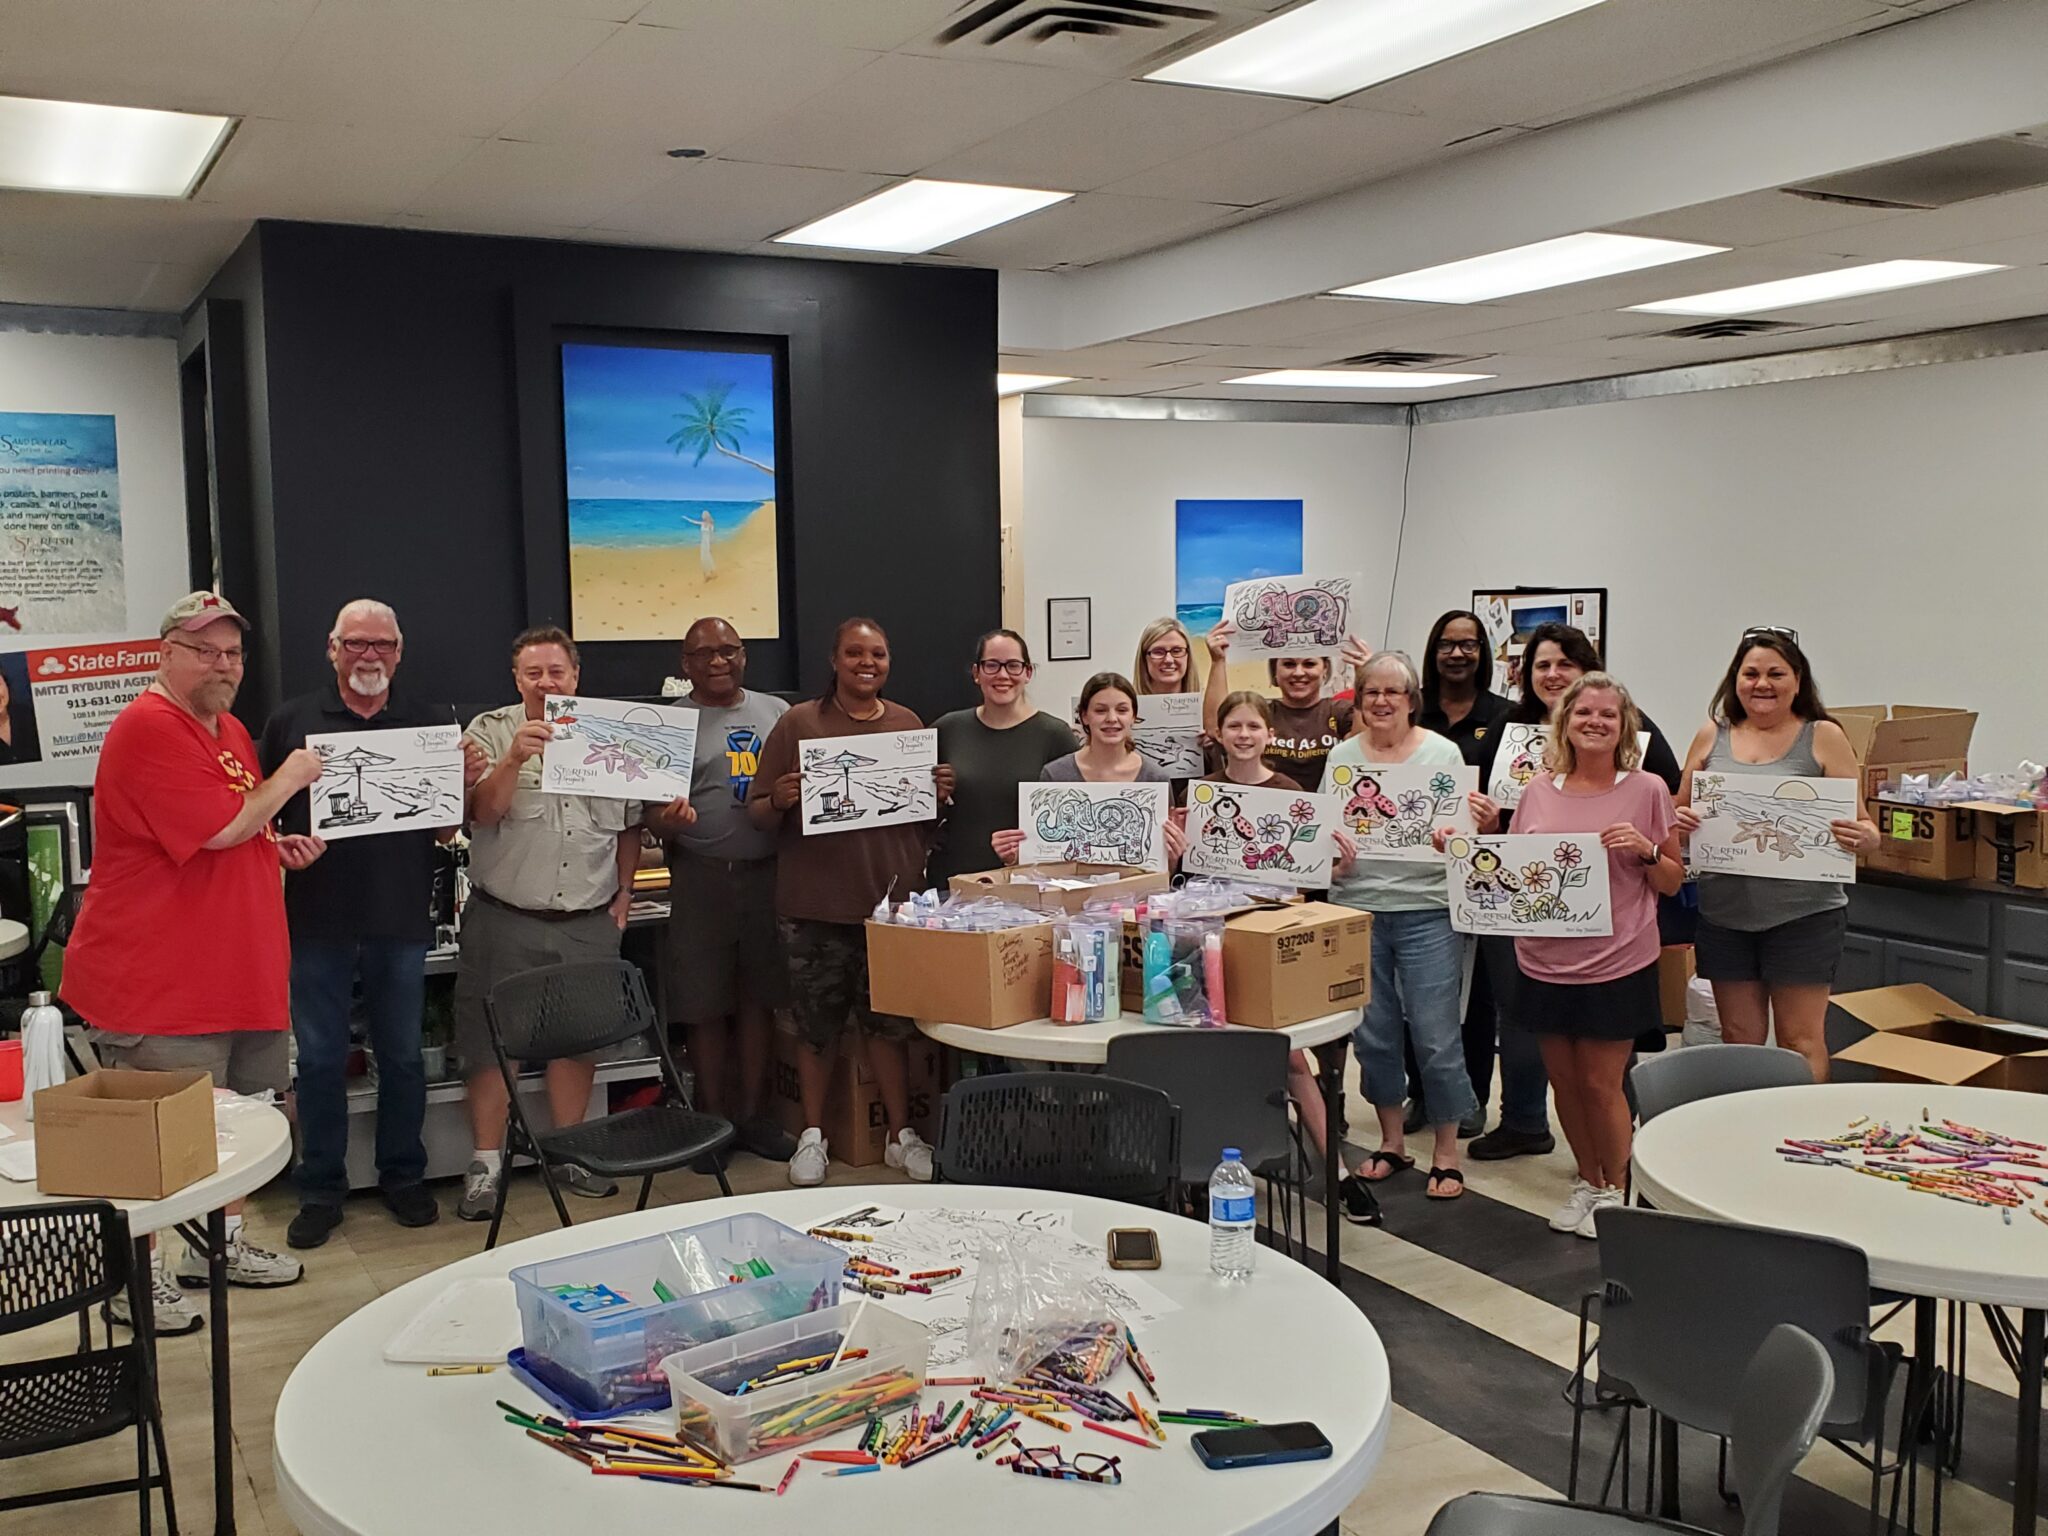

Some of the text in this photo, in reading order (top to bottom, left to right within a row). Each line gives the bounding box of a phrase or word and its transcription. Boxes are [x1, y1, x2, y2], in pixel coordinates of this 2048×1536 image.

[12, 466, 34, 474] need
[37, 467, 70, 476] printing
[41, 489, 78, 499] banners,
[80, 490, 98, 500] peel
[49, 500, 60, 508] All
[62, 500, 71, 508] of
[73, 500, 98, 509] these
[6, 511, 23, 519] and
[26, 512, 49, 521] many
[51, 512, 75, 520] more
[76, 512, 91, 520] can
[93, 511, 105, 520] be
[4, 522, 27, 530] done
[28, 522, 49, 530] here
[34, 675, 156, 697] MITZI RYBURN AGEN
[52, 731, 106, 744] Mitzi@Mit
[1271, 737, 1295, 749] ted
[1298, 738, 1317, 751] As
[51, 744, 100, 759] www.Mit
[1265, 747, 1288, 757] aking
[1297, 748, 1329, 758] Differen
[725, 751, 758, 776] 70
[1878, 805, 1935, 840] EGS
[1277, 930, 1315, 950] 937208
